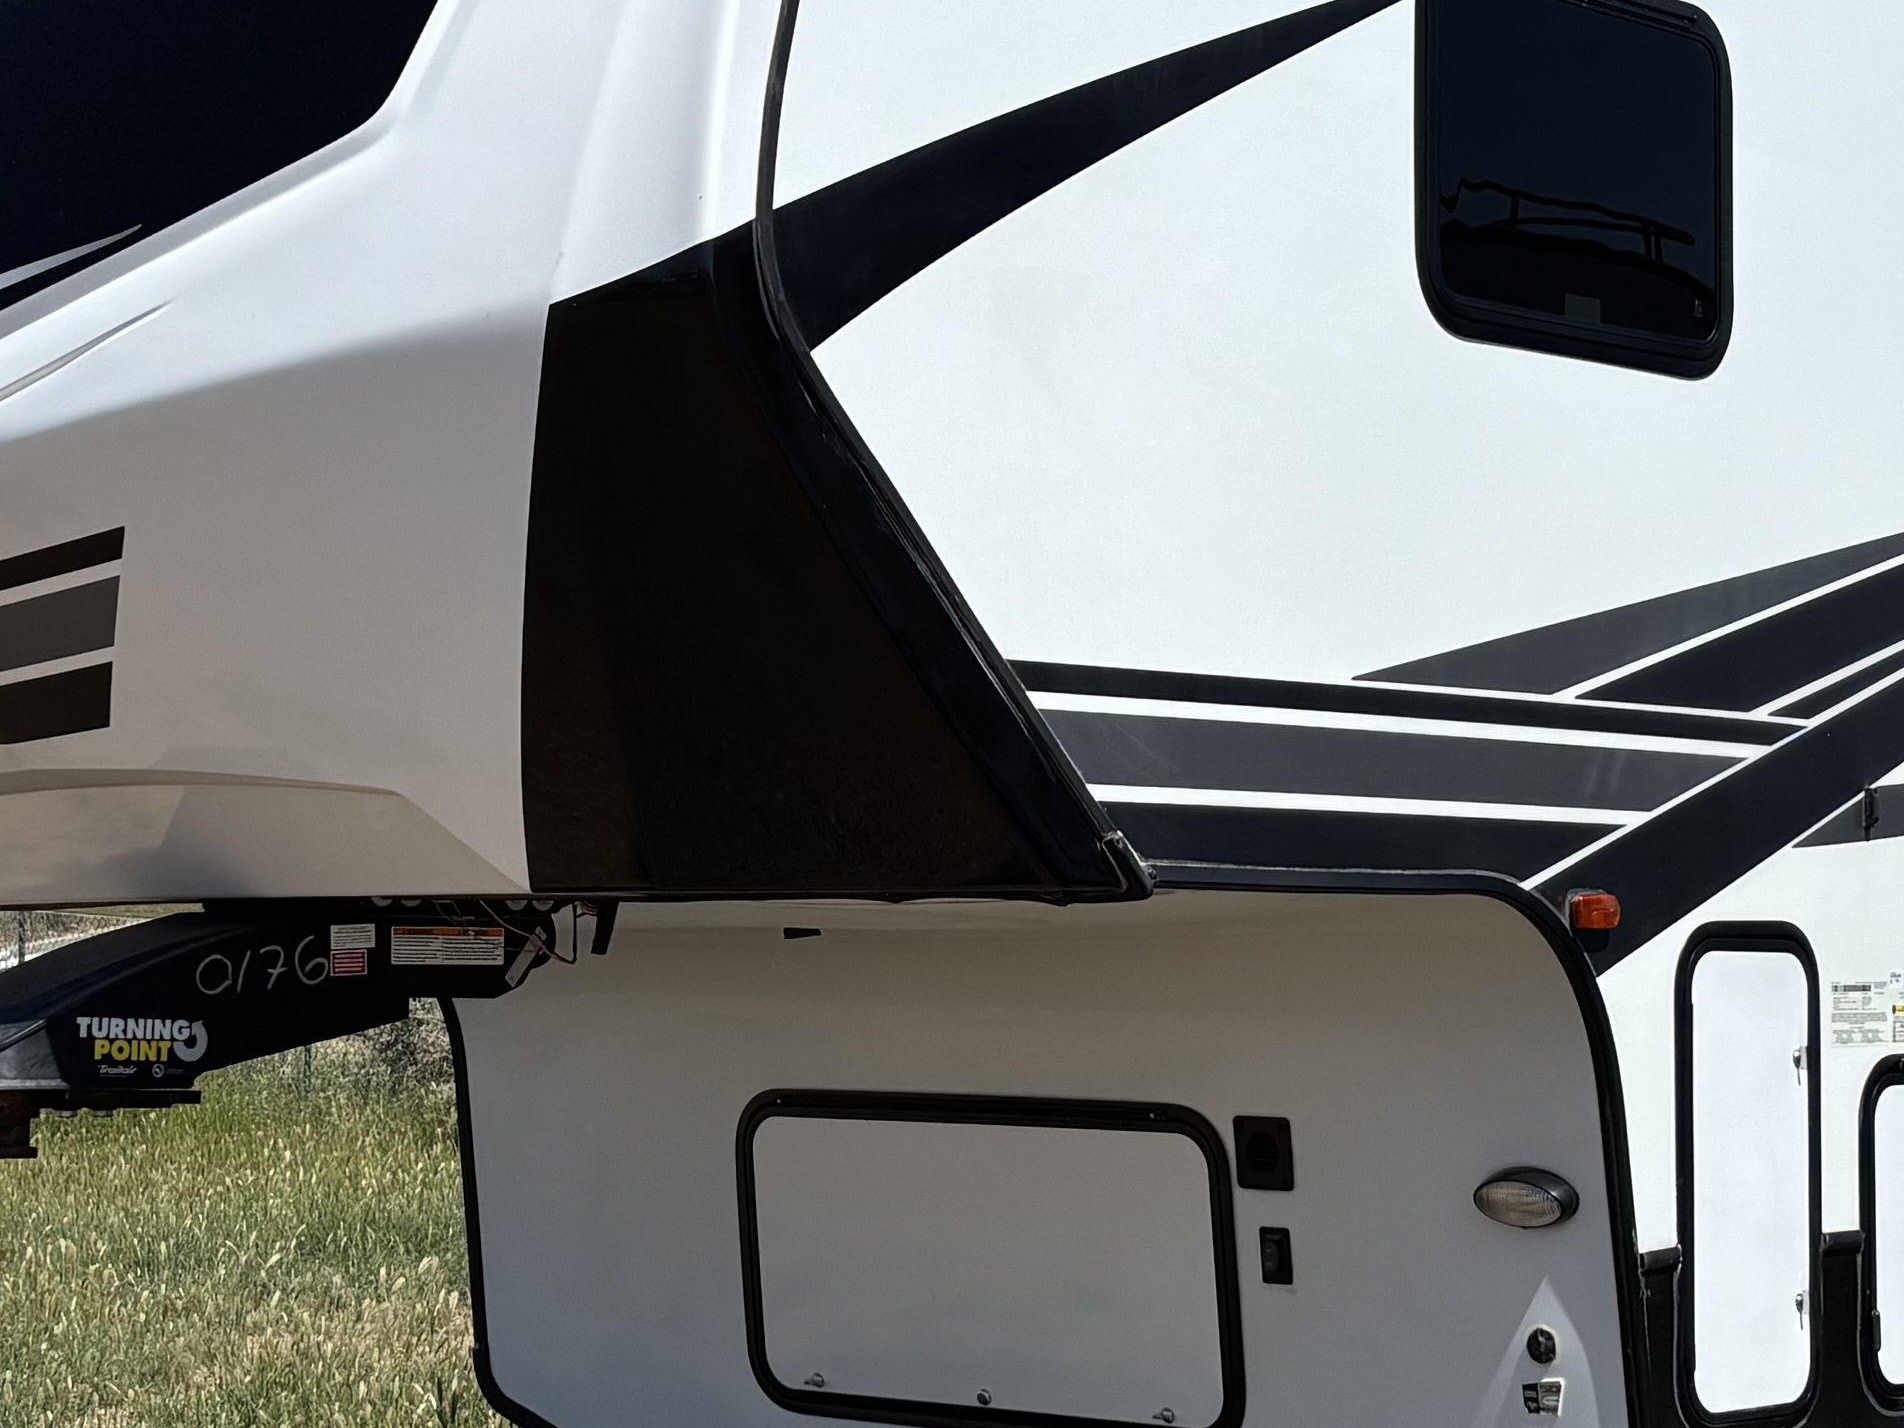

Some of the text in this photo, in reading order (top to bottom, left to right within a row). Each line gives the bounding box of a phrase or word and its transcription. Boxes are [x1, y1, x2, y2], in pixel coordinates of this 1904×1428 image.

[195, 934, 329, 995] 0176
[76, 1016, 191, 1041] TURNING
[93, 1038, 172, 1062] POINT
